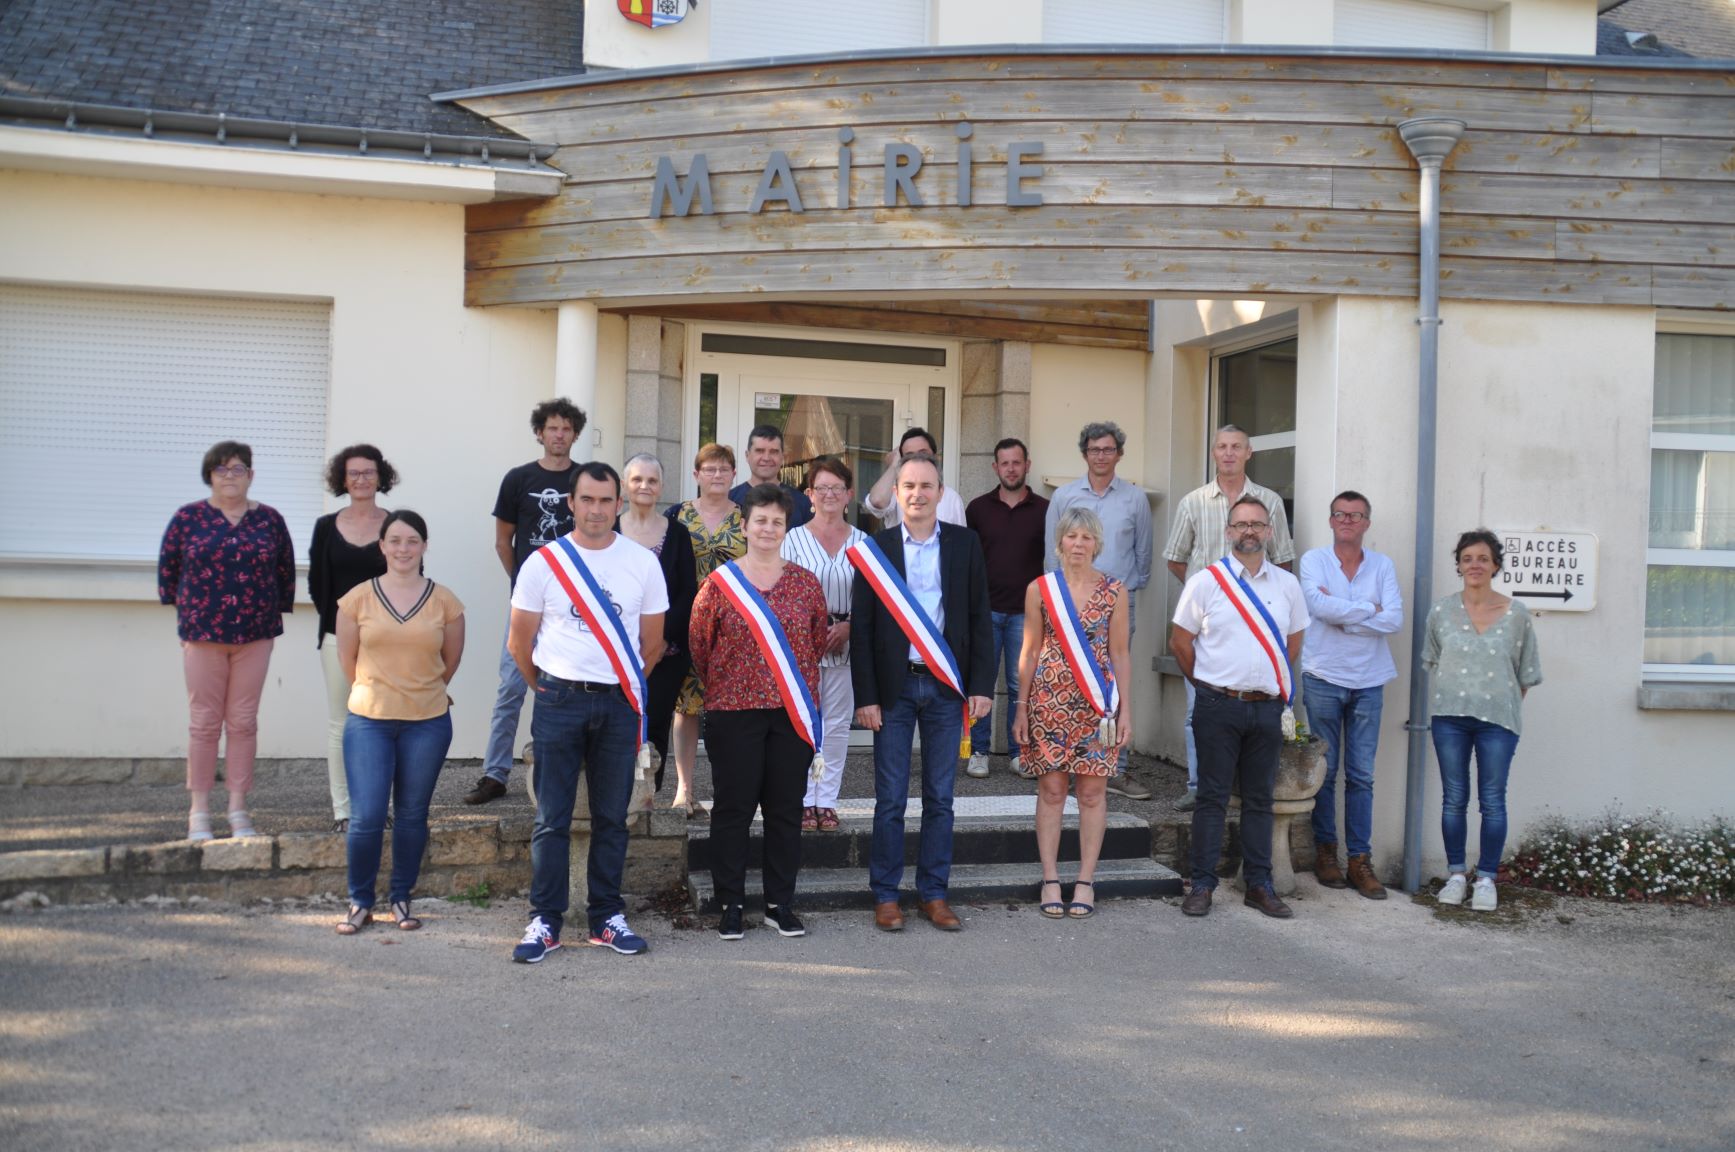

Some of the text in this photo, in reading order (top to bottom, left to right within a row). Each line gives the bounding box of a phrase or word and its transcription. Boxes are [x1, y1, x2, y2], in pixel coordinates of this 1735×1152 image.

[1525, 538, 1577, 553] ACCÈS
[1511, 556, 1578, 569] BUREAU
[1503, 571, 1585, 586] DU MAIRE
